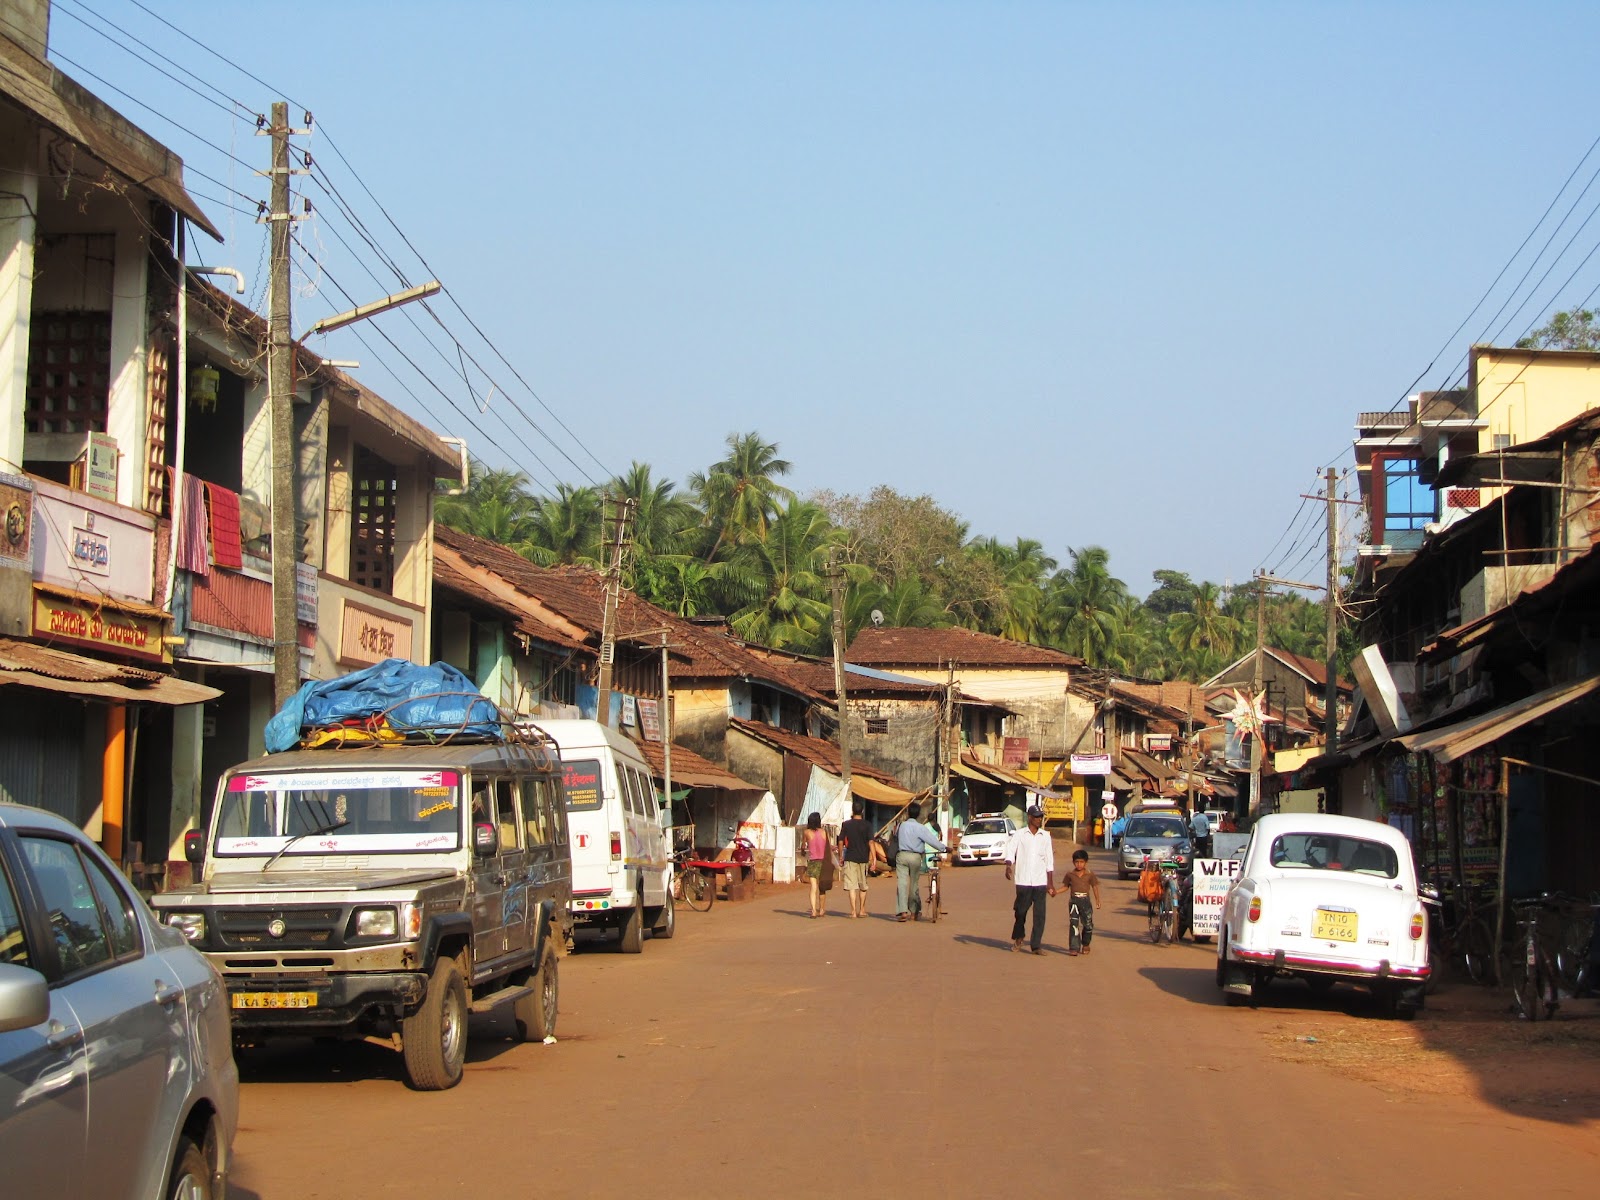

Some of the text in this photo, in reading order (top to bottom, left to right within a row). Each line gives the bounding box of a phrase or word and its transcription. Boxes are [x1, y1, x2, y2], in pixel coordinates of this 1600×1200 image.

[576, 834, 589, 848] T
[1193, 913, 1208, 921] BIKE
[1323, 913, 1336, 922] TN
[1318, 926, 1324, 935] P
[241, 998, 259, 1007] KA
